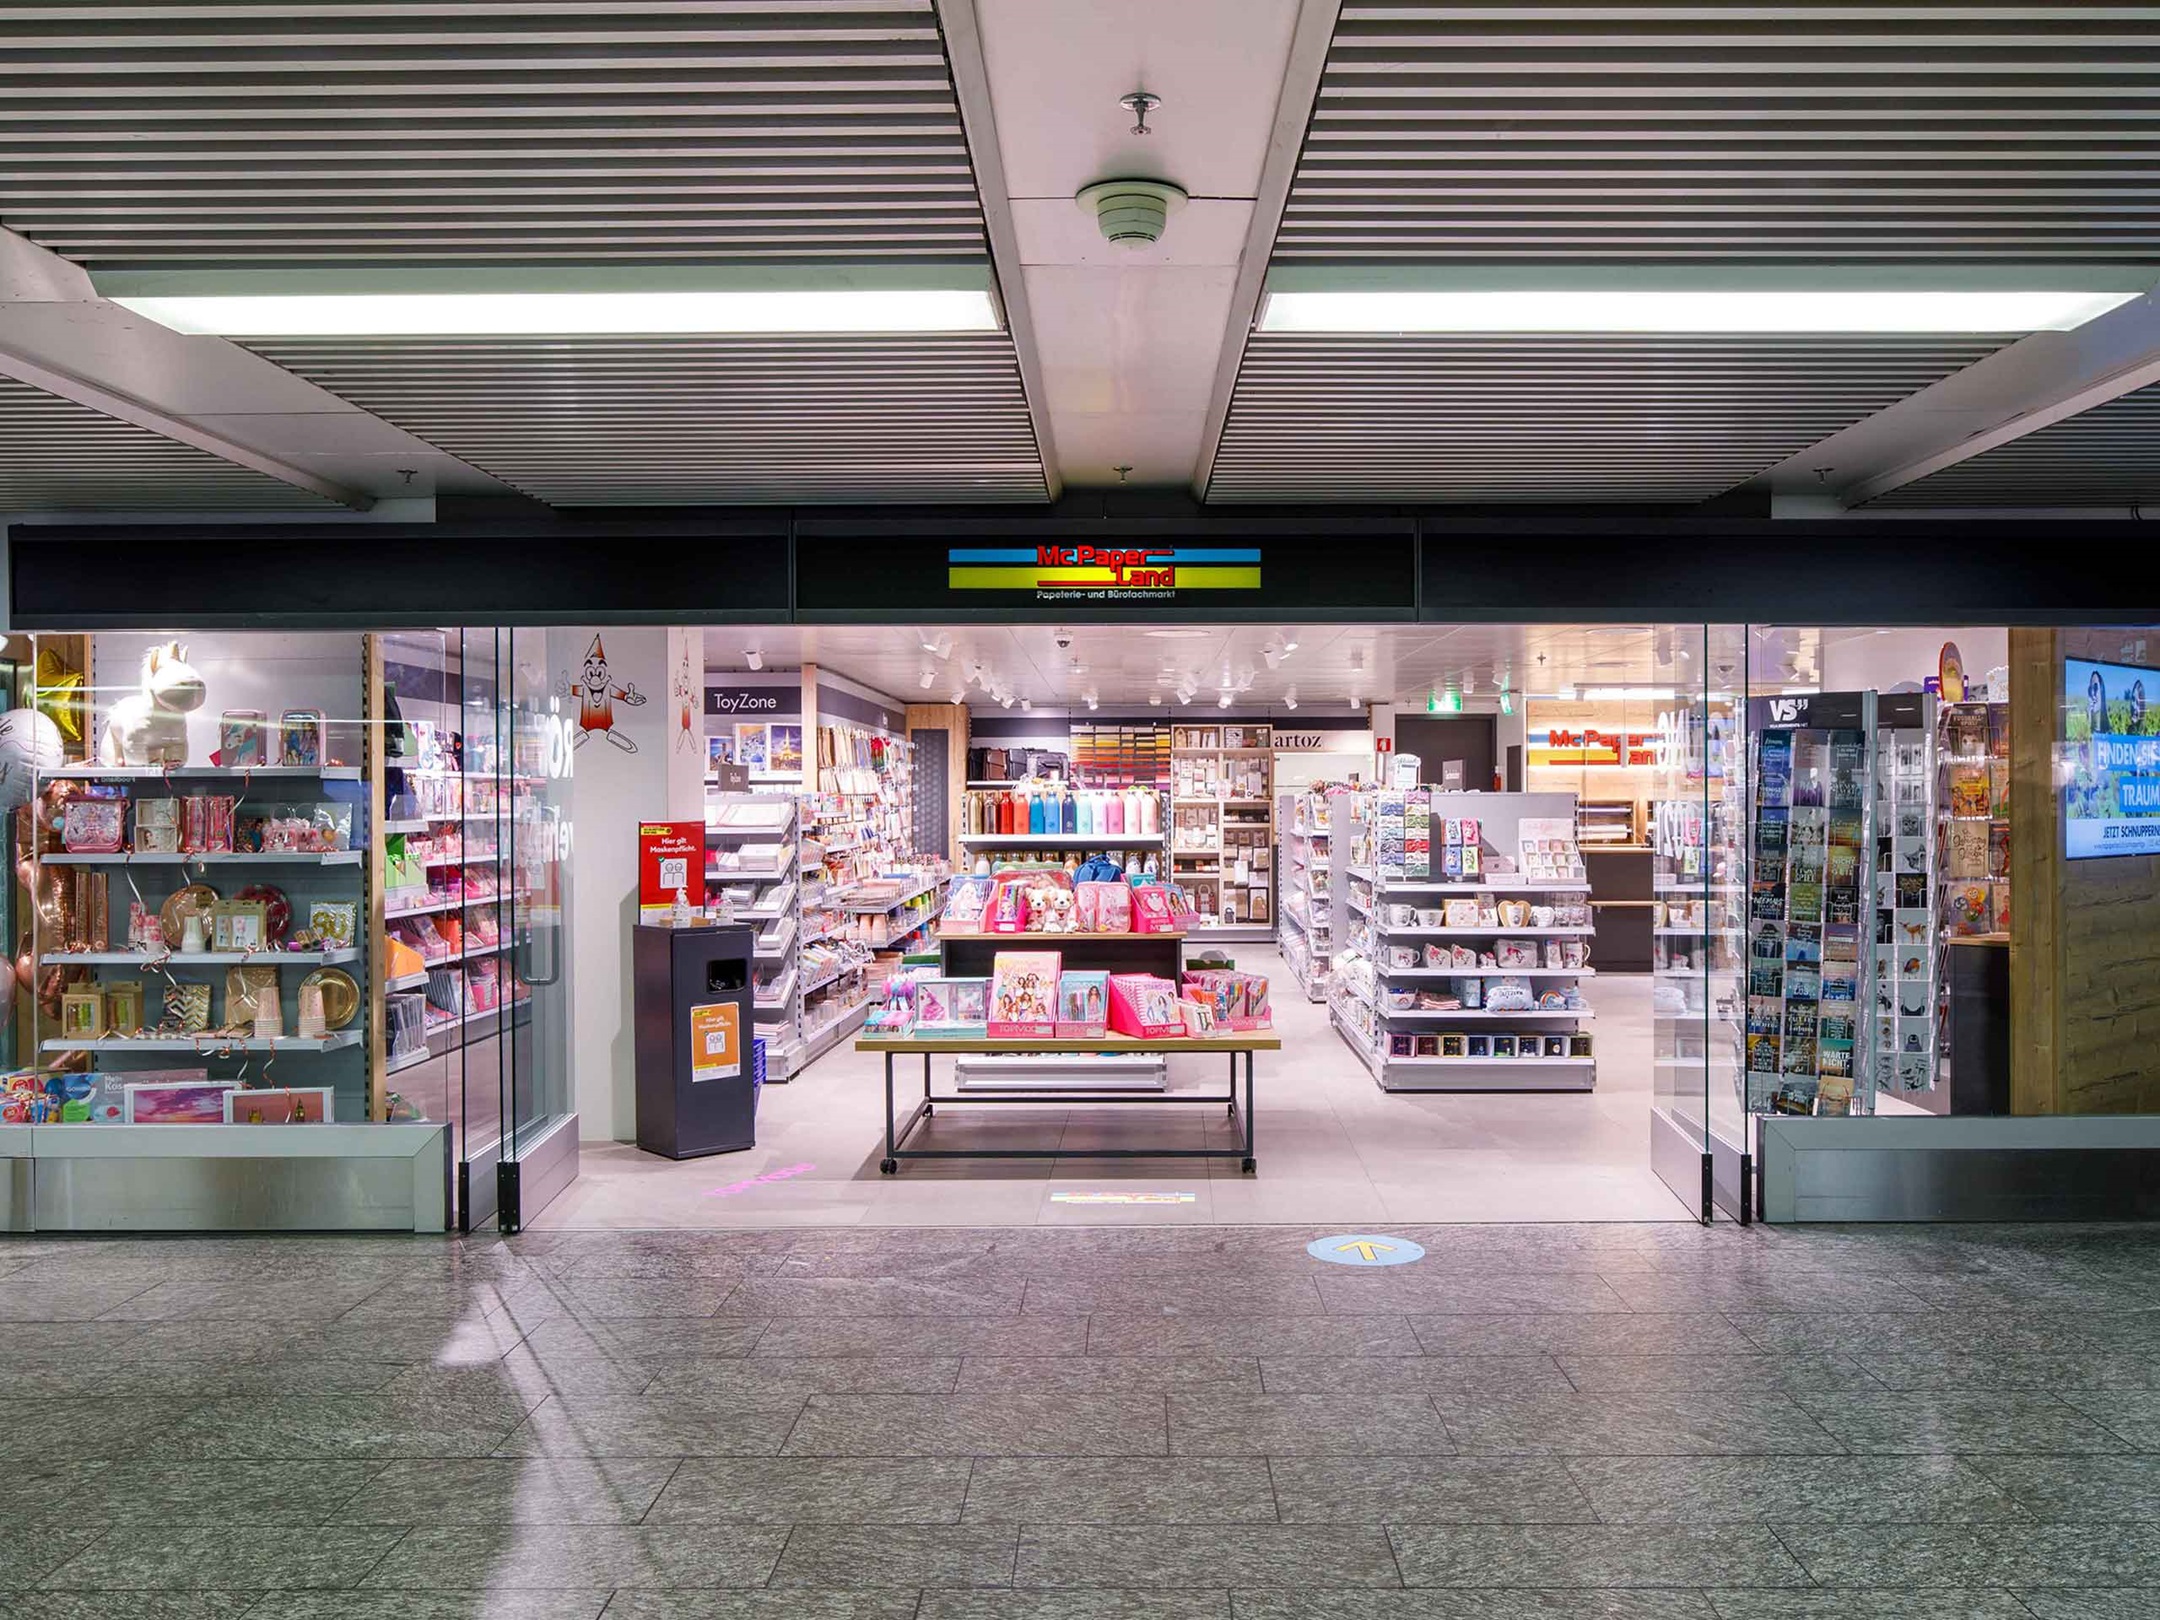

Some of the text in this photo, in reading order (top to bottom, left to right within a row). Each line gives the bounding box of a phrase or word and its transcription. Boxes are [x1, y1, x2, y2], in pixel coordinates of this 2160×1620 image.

[1115, 565, 1175, 587] Land
[1036, 589, 1176, 601] Papeterie- und Bürofachmarkt
[713, 693, 777, 713] ToyZone
[1274, 734, 1322, 748] artoz
[2097, 741, 2137, 766] FINDEN
[2103, 825, 2120, 839] JETZT
[661, 837, 687, 846] Hier gilt
